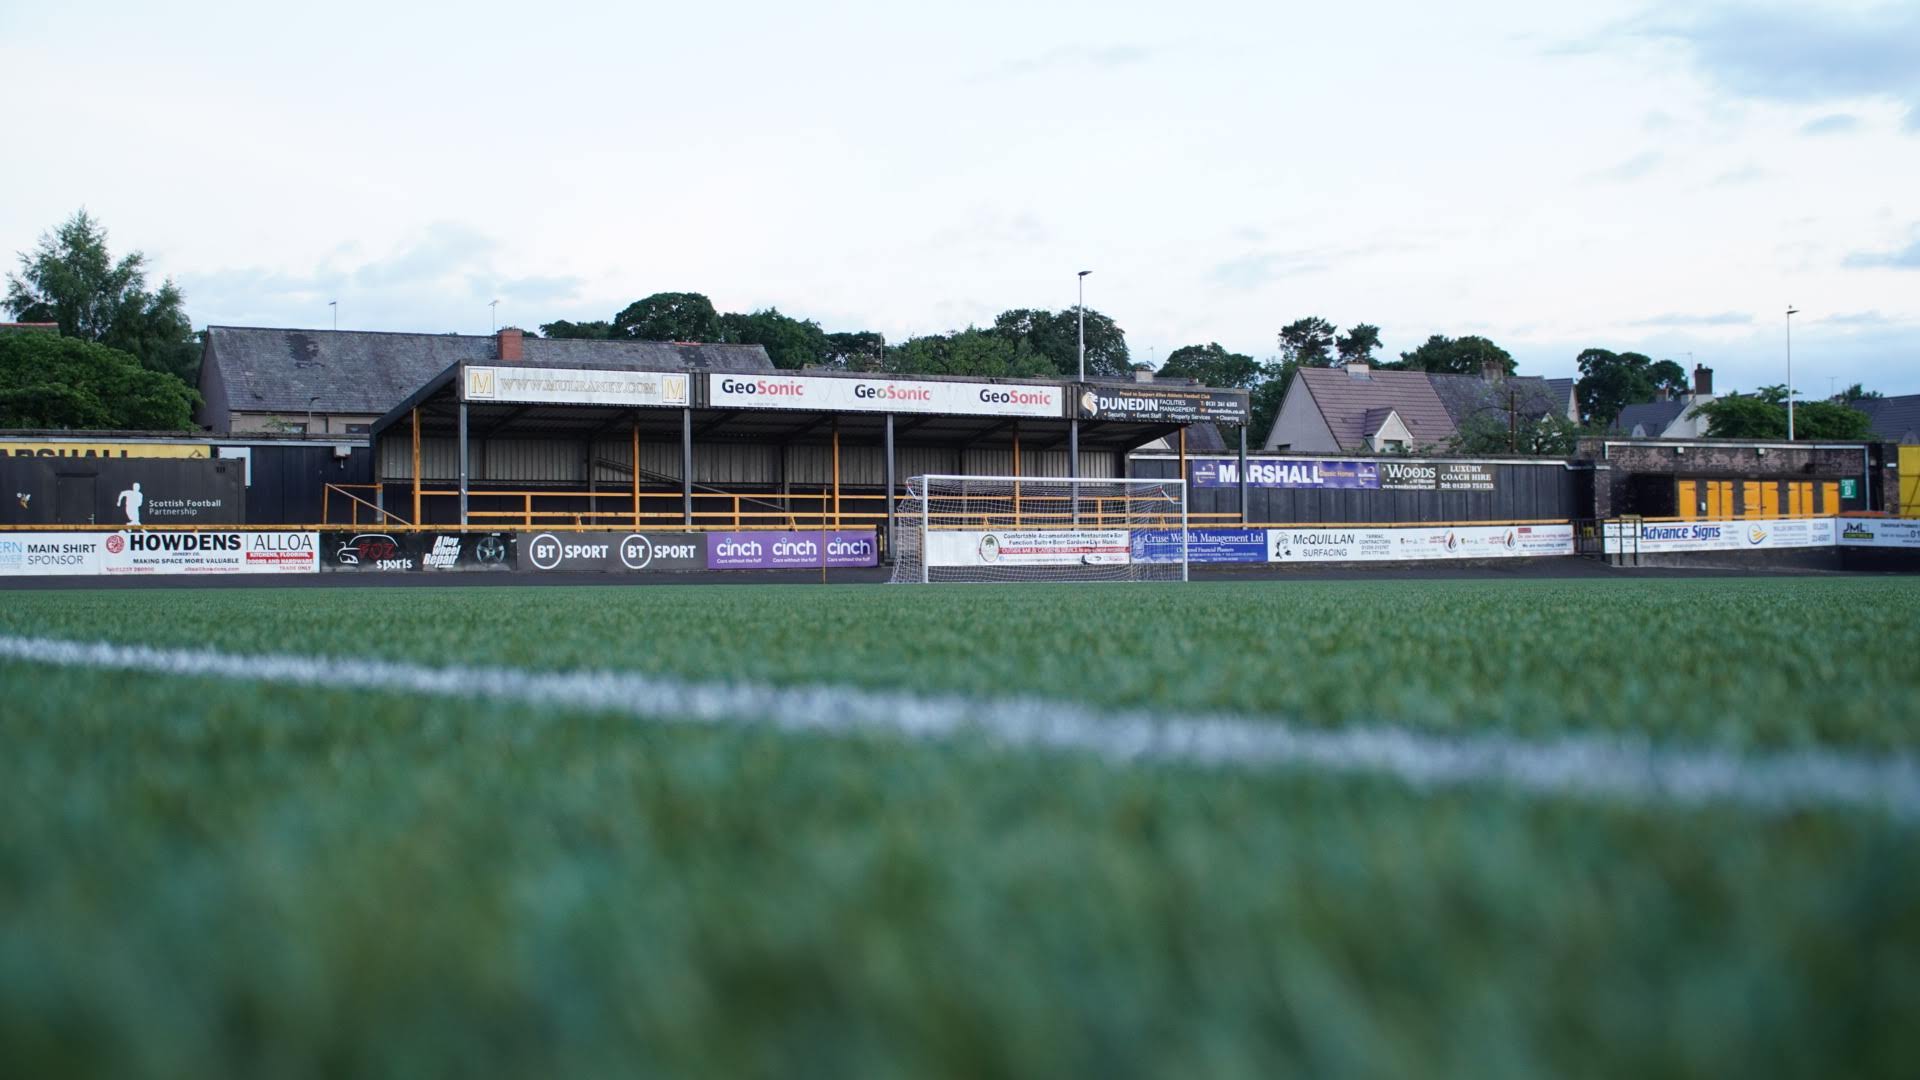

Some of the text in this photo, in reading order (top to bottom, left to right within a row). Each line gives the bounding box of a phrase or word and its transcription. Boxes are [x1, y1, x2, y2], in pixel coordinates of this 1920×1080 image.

[471, 372, 493, 394] M
[500, 378, 657, 394] WWW.MULRANEY.COM
[664, 379, 684, 400] M
[722, 379, 803, 396] GeoSonic
[855, 384, 930, 400] GeoSonic
[979, 389, 1050, 405] GeoSonic
[1100, 397, 1158, 412] DUNEDIN
[1450, 465, 1482, 473] LUXURY
[149, 499, 222, 508] Scottish Football
[149, 508, 198, 516] Partnership
[1642, 526, 1688, 540] Advance
[1692, 524, 1721, 541] Signs
[1843, 522, 1866, 532] JML
[130, 534, 242, 551] HOWDENS
[254, 534, 313, 550] ALLOA
[772, 537, 817, 556] cinch
[827, 536, 871, 555] cinch
[1144, 532, 1264, 546] Cruse Welth Management Ltd
[1293, 534, 1355, 545] McQUILLAN
[28, 544, 96, 554] MAIN SHIRT
[537, 544, 608, 559] BT SPORT
[627, 544, 696, 559] BT SPORT
[716, 537, 762, 557] cinch
[1302, 548, 1348, 557] SURFACING
[28, 555, 84, 565] SPONSOR
[376, 558, 412, 570] sports
[423, 554, 458, 568] Repair
